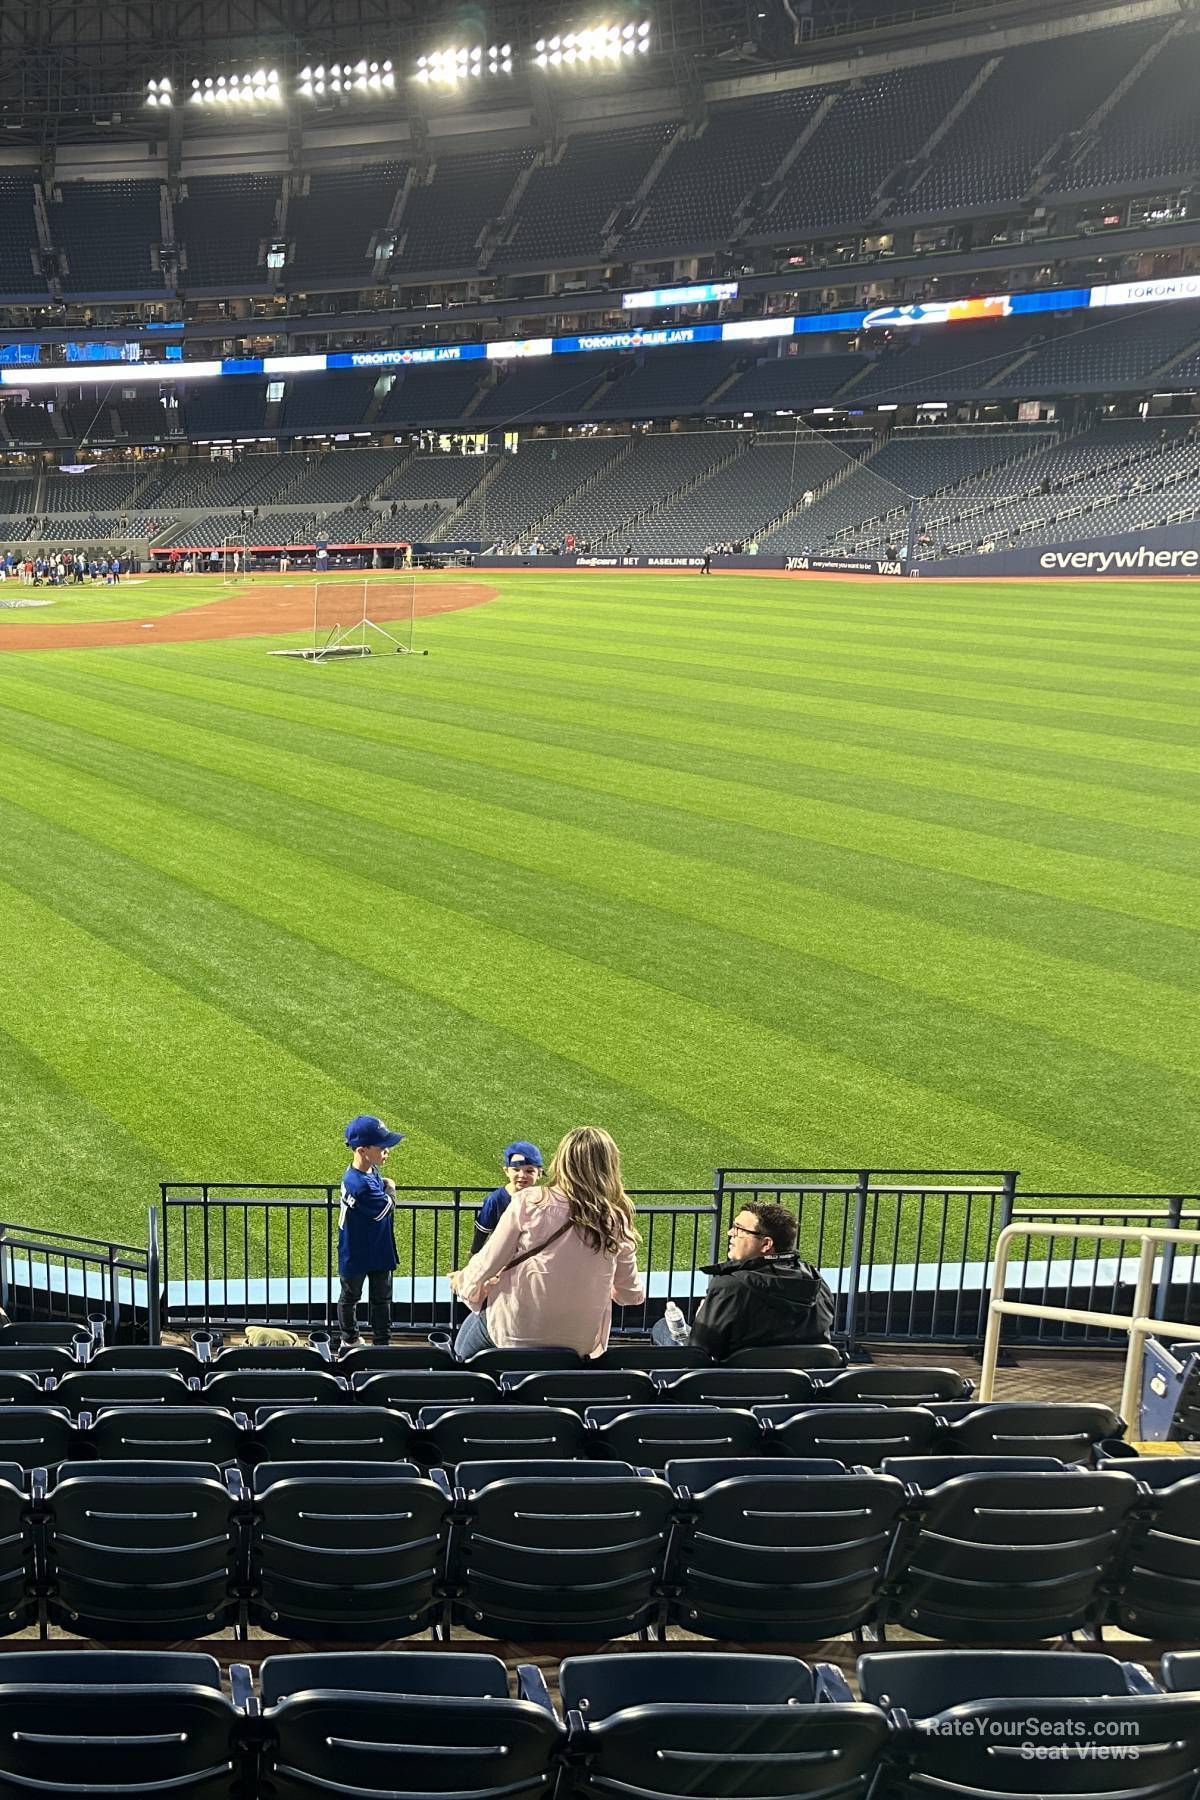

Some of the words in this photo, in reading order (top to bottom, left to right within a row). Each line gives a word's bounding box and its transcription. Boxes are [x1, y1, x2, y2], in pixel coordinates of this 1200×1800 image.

[1127, 283, 1198, 298] TORONTO
[579, 336, 630, 349] TORONTO
[643, 332, 667, 345] BLUE
[668, 330, 694, 342] JAYS
[352, 353, 400, 365] TORONTO
[412, 350, 435, 362] BLUE
[437, 348, 460, 359] JAYS
[576, 557, 617, 566] theScore
[623, 557, 639, 565] BET
[786, 556, 809, 569] VISA
[876, 561, 901, 574] VISA
[1040, 547, 1199, 572] everywhere
